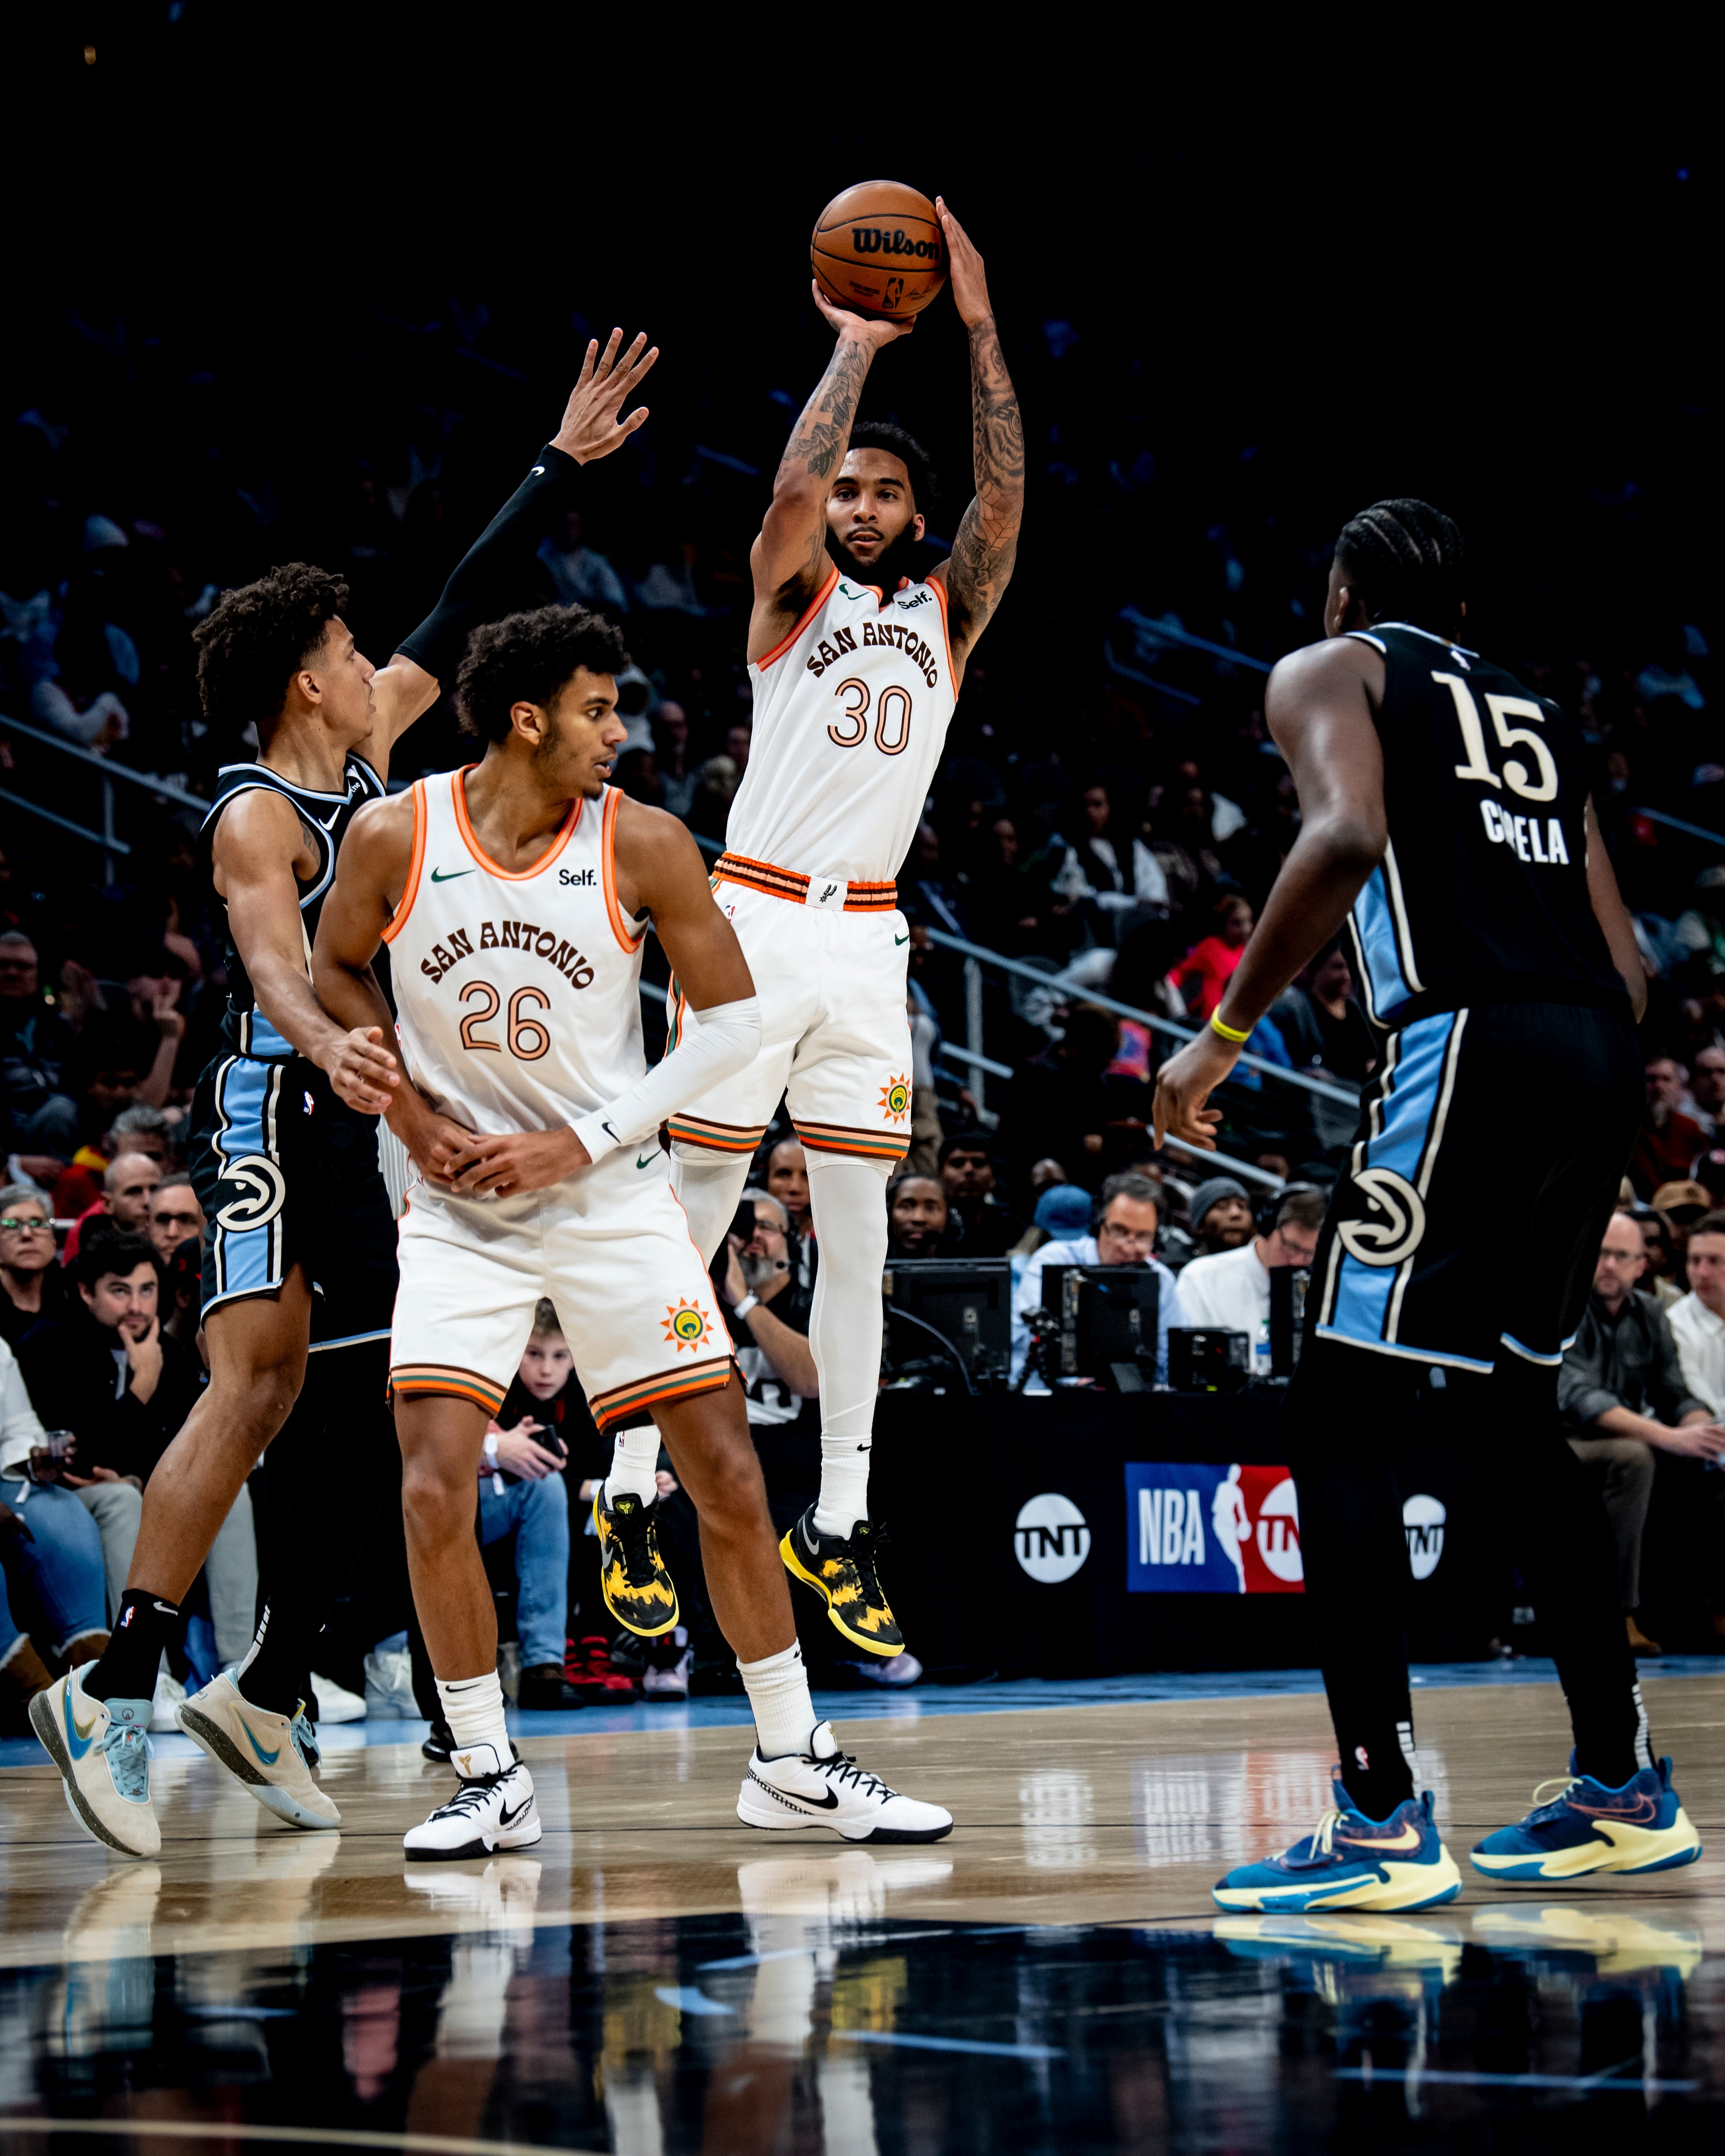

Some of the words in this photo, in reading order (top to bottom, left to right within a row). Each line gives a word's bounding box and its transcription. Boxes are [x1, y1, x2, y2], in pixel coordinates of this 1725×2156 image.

[852, 228, 940, 261] Wilson
[897, 591, 932, 609] Self.
[807, 626, 858, 678] SAN
[862, 622, 938, 688] ANTONIO
[827, 677, 913, 756] 30
[1431, 670, 1558, 802] 15
[350, 782, 360, 793] the
[1480, 799, 1569, 865] CELA
[559, 869, 597, 886] Self.
[420, 928, 475, 985] SAN
[480, 921, 594, 990] ANTONIO
[459, 980, 551, 1061] 26
[1015, 1524, 1087, 1559] TNT
[1139, 1488, 1205, 1565] NBA
